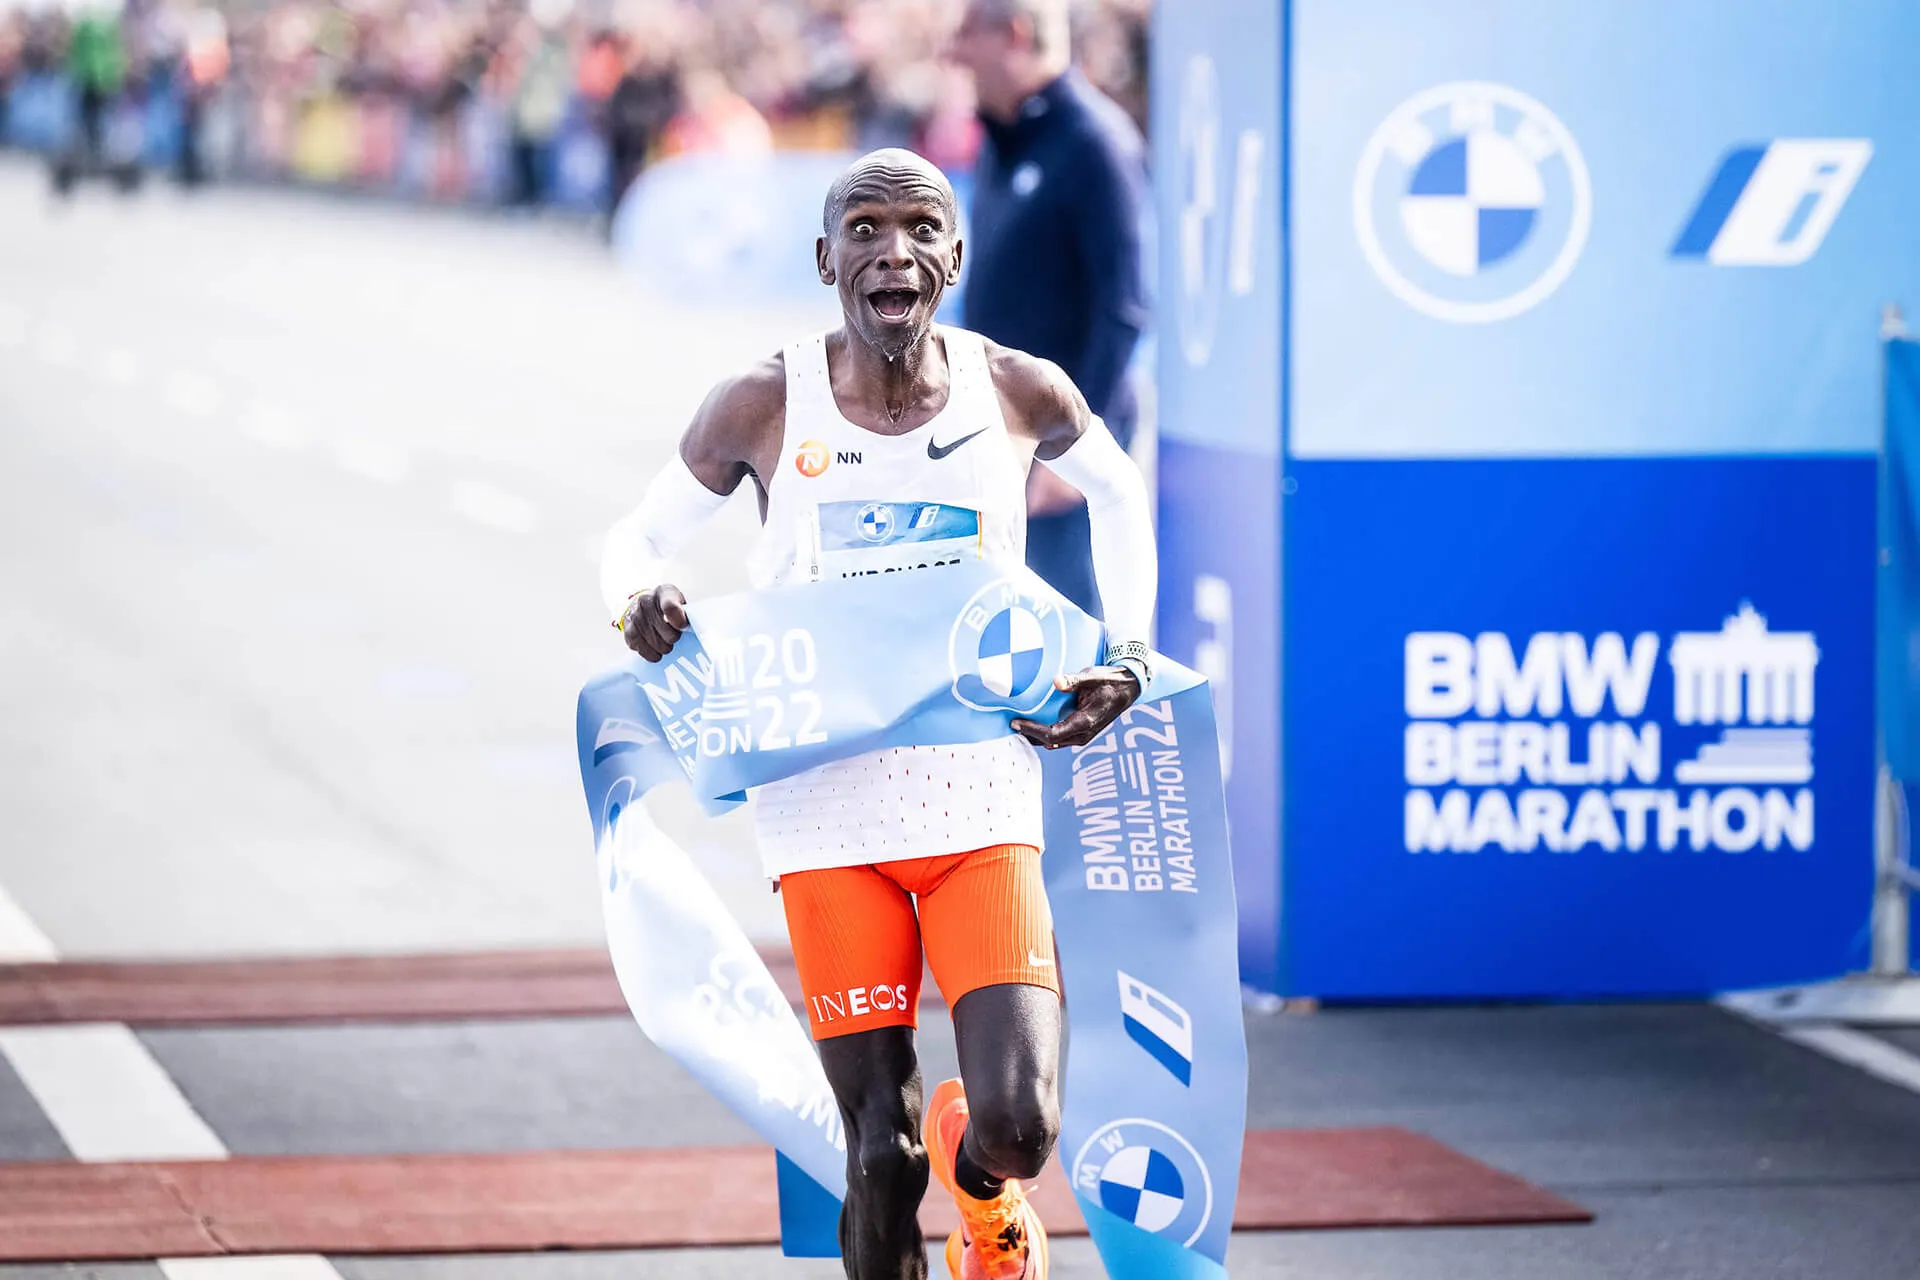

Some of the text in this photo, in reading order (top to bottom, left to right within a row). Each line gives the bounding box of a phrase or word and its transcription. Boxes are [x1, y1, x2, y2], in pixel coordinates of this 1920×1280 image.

[836, 452, 863, 465] NN
[964, 584, 1053, 632] BMW
[748, 628, 818, 690] 20
[1405, 632, 1660, 717] BMW
[755, 690, 828, 751] 22
[1405, 721, 1661, 786] BERLIN
[1076, 806, 1130, 892] BMW
[1124, 800, 1163, 892] BERLIN
[1151, 749, 1198, 893] MARATHON
[1405, 788, 1815, 853] MARATHON
[811, 984, 907, 1023] INEOS
[1078, 1129, 1125, 1189] MW
